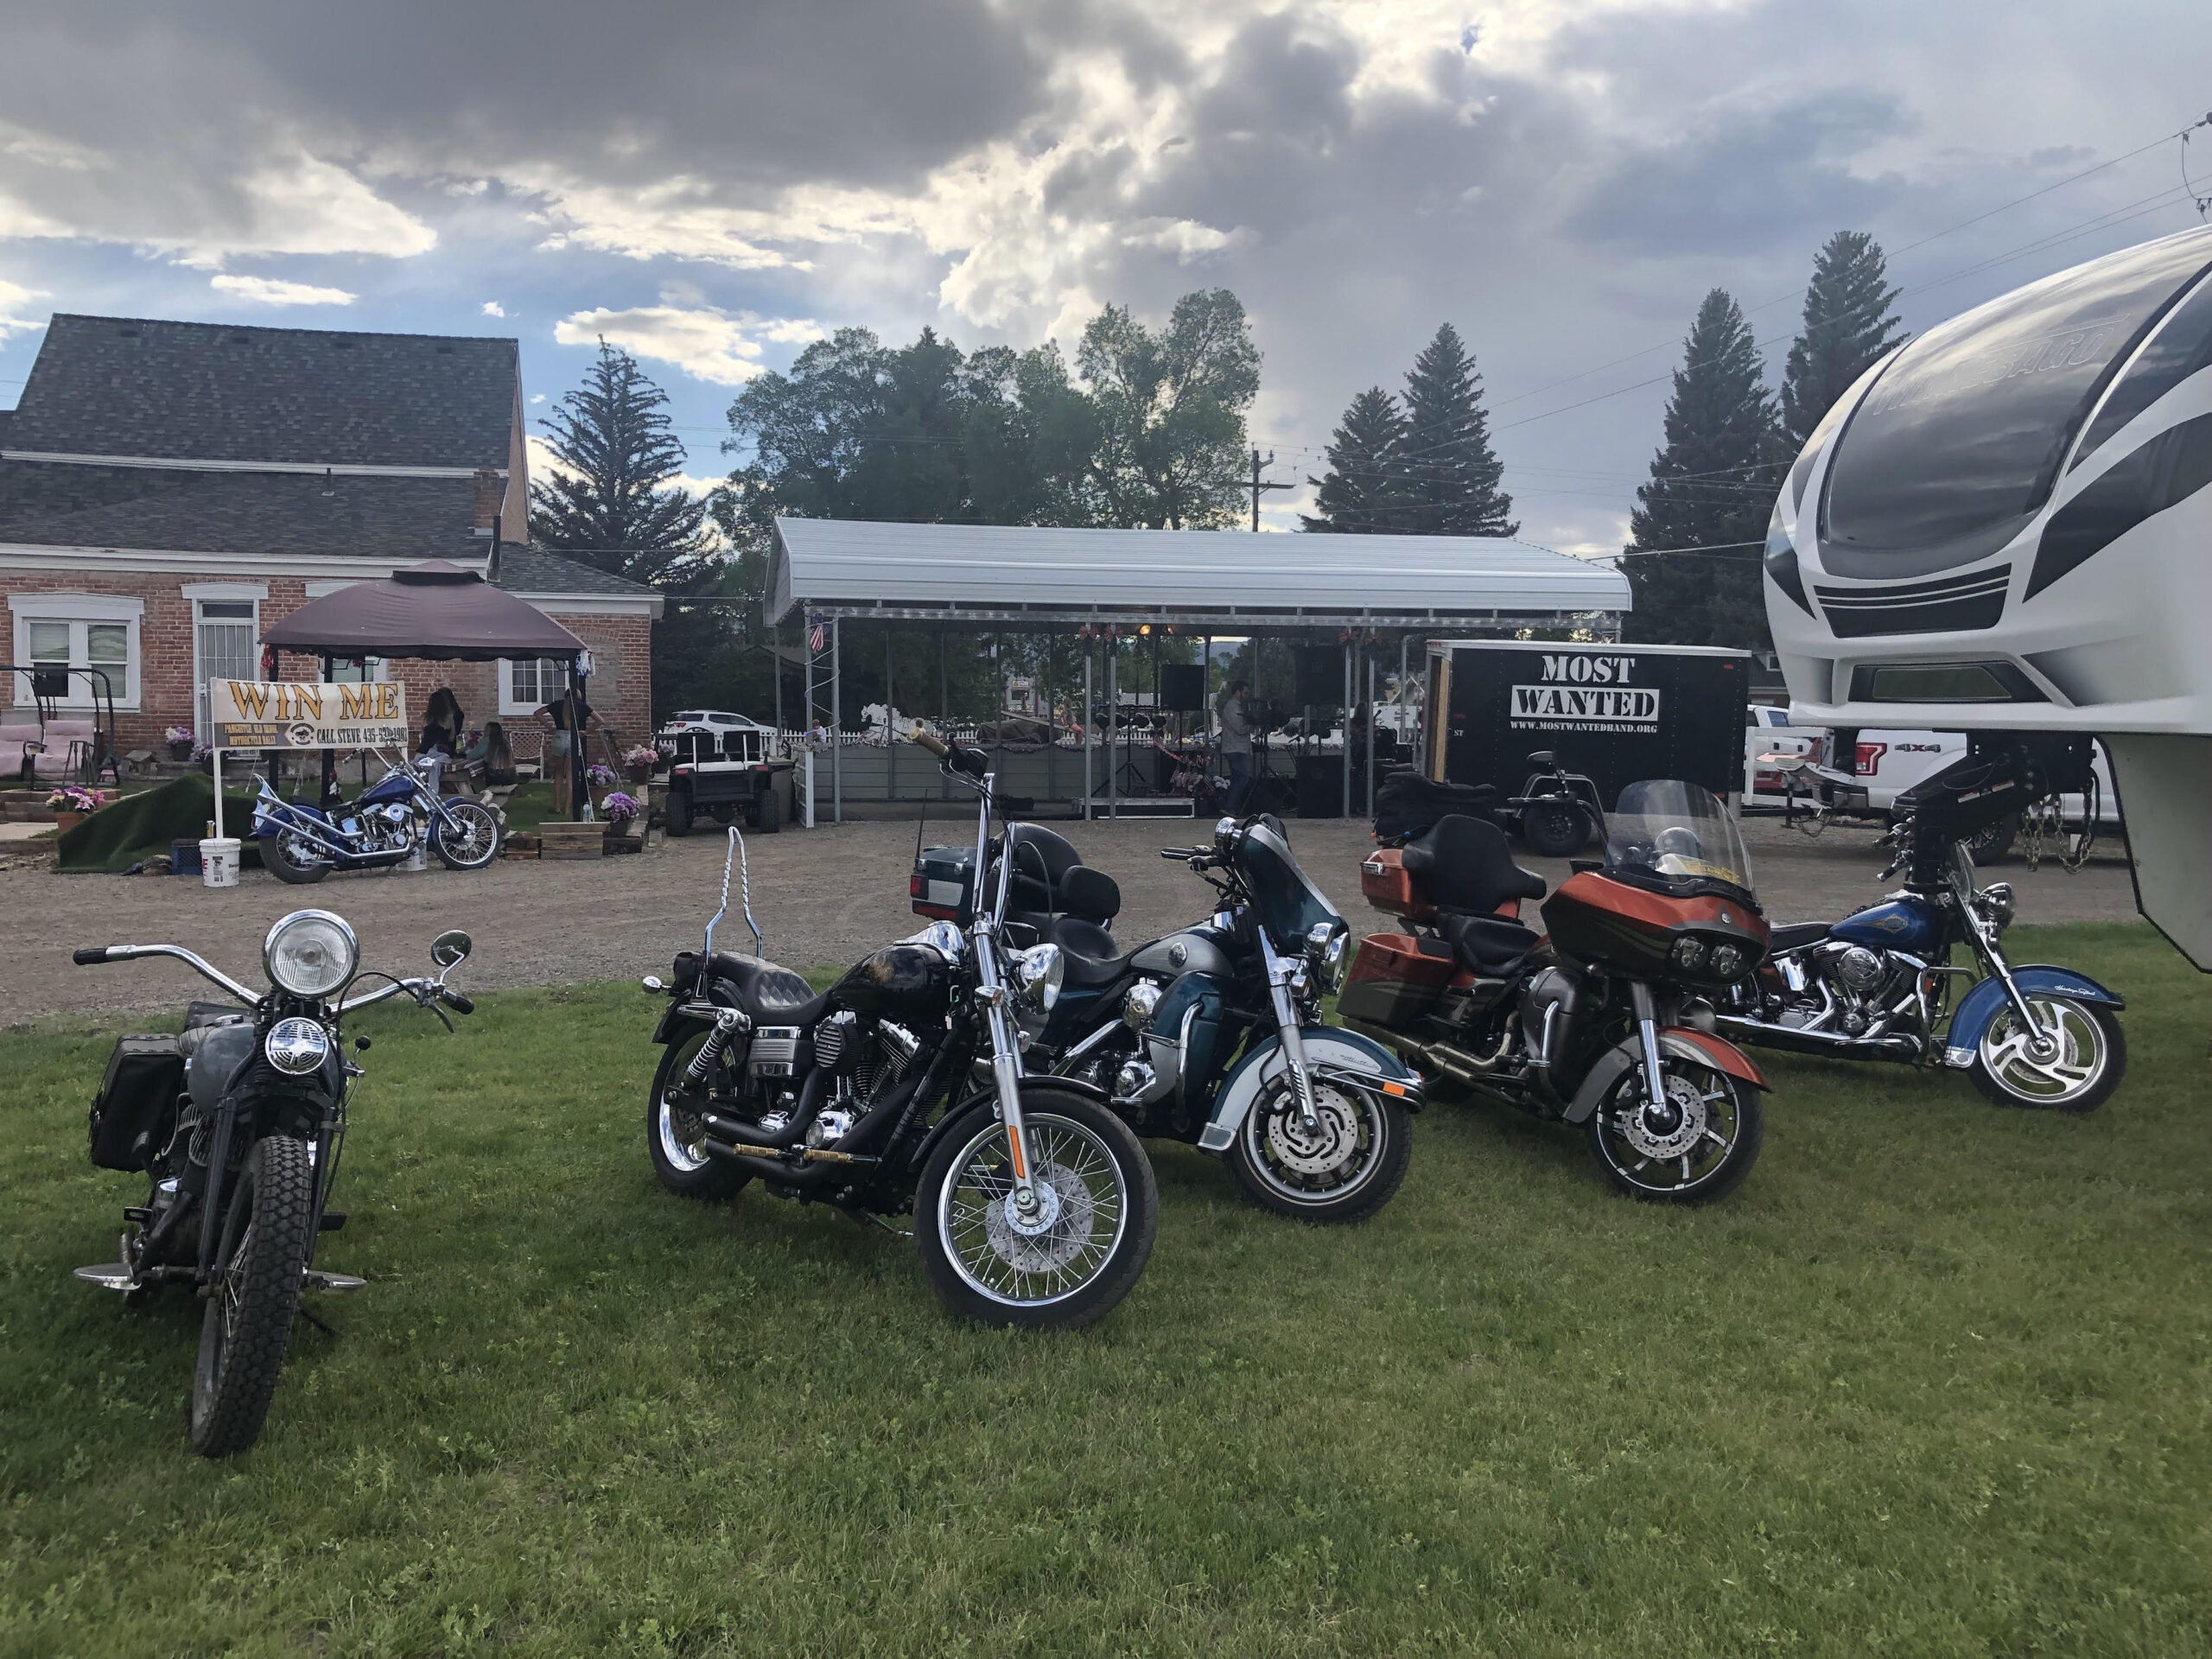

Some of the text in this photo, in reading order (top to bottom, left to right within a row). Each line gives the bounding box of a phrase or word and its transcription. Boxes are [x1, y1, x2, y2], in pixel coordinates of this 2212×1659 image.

[1541, 655, 1636, 683] MOST
[227, 681, 397, 720] WIN ME
[1516, 689, 1655, 717] WANTED
[317, 728, 336, 744] CALL
[337, 728, 361, 743] STEVE
[1510, 721, 1657, 734] WWW.MOSTWANTEDBAND.ORG
